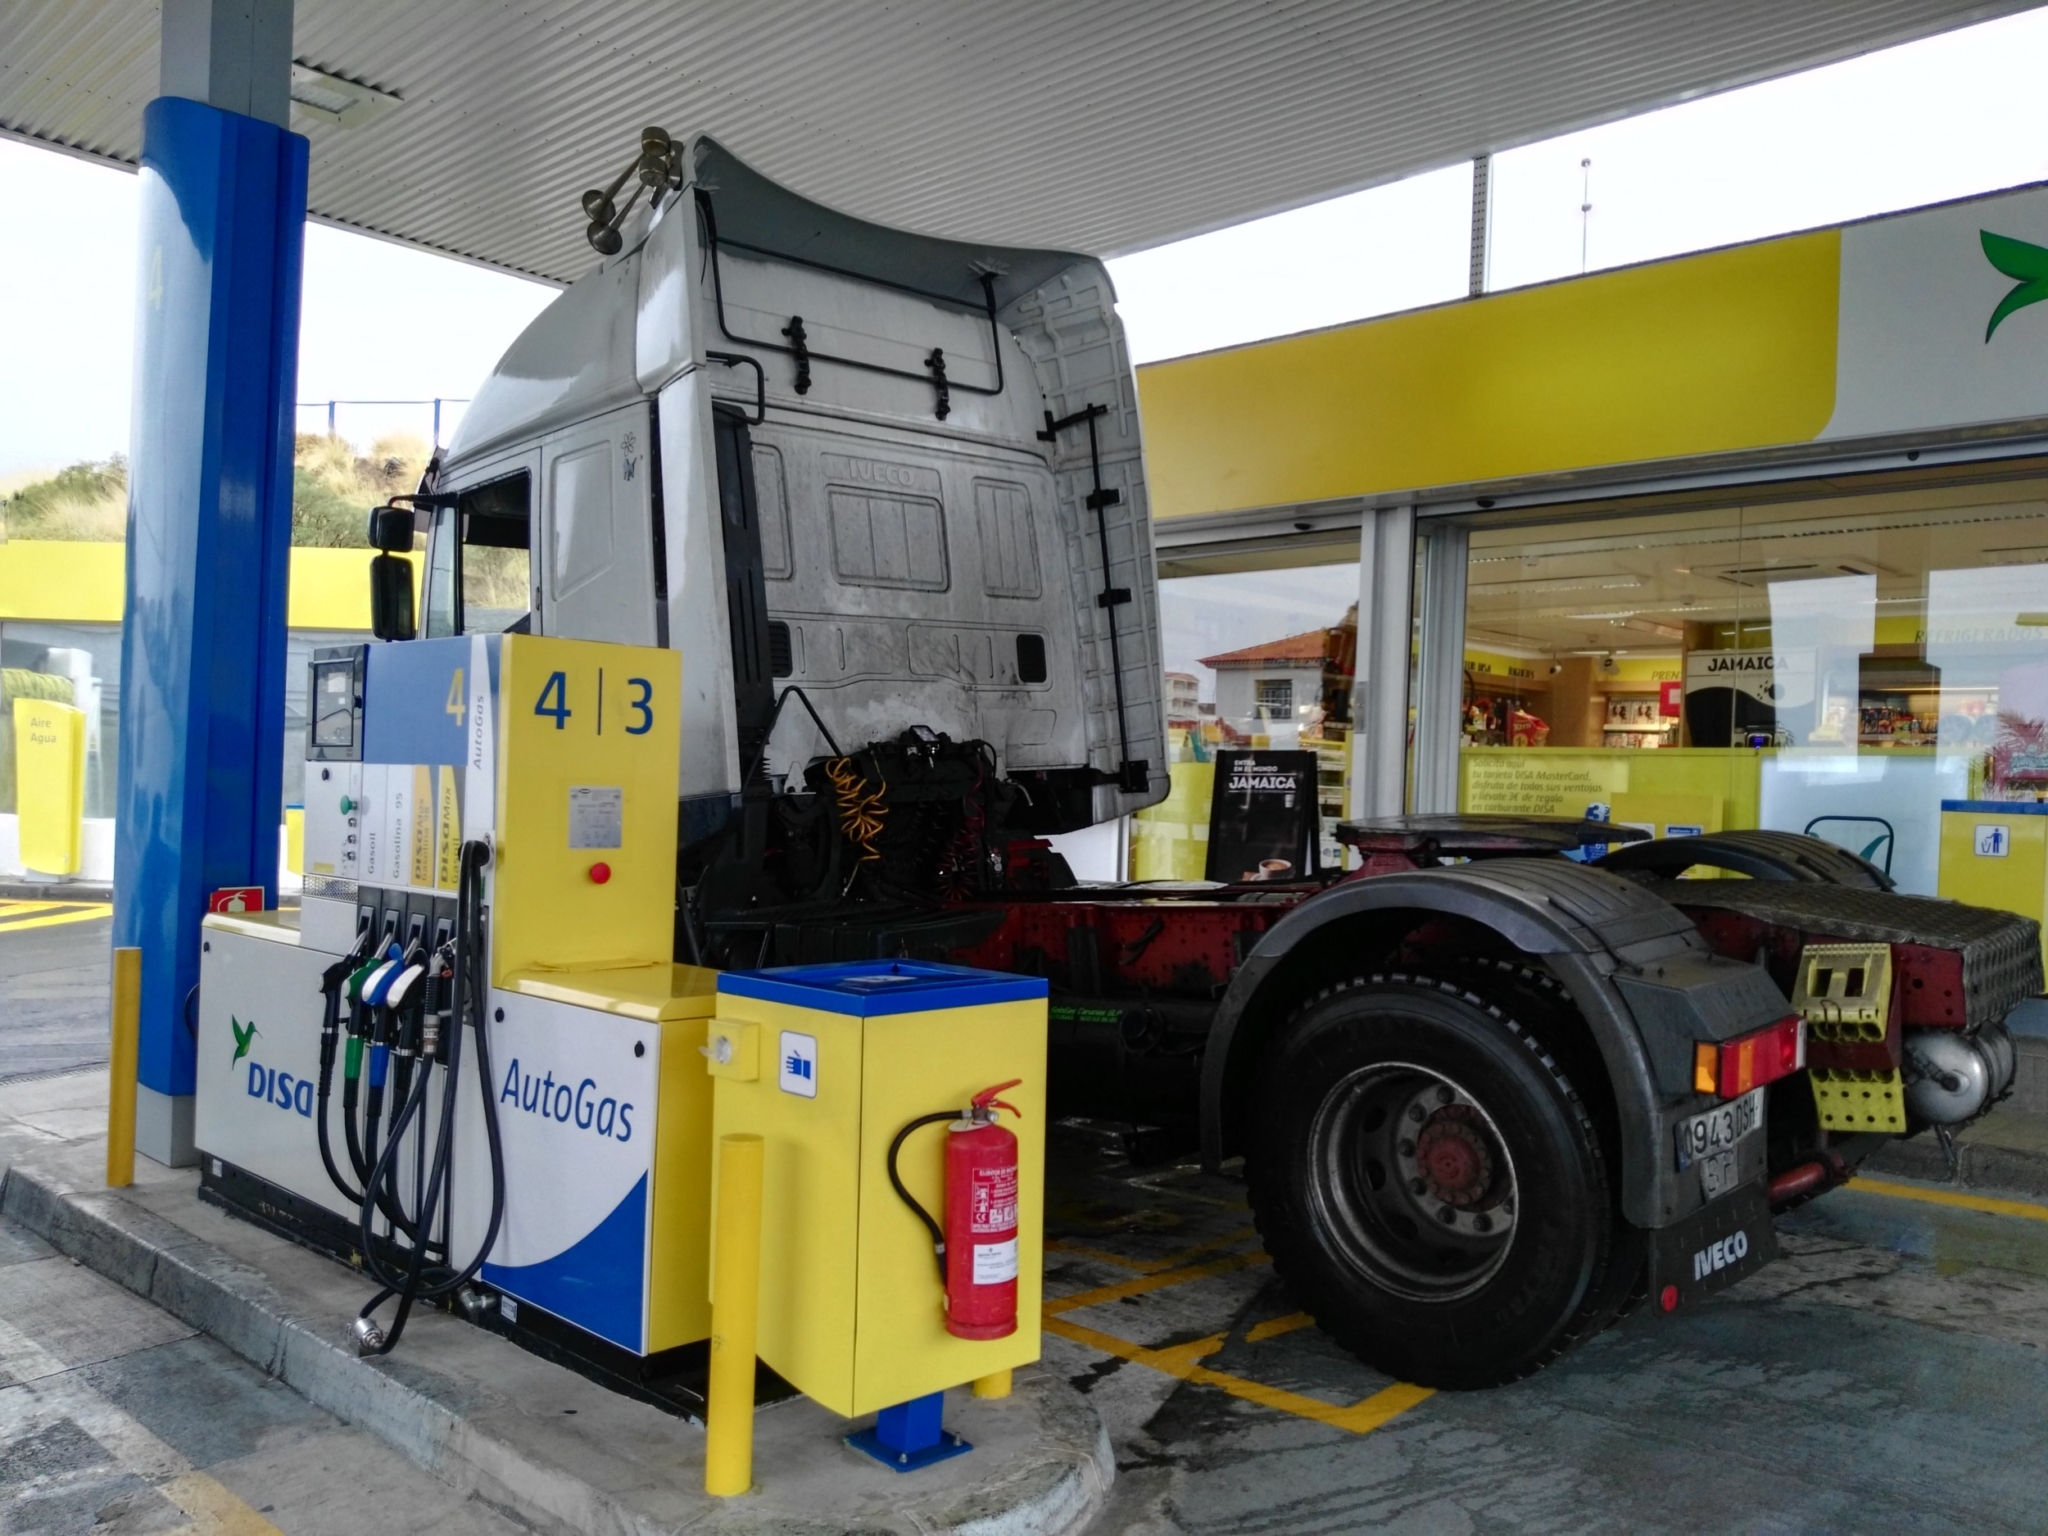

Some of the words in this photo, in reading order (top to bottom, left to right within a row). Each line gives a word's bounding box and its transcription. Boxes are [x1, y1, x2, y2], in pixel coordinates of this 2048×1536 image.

[848, 458, 915, 487] IVECO
[1914, 627, 2044, 644] REFRIGERADOS
[1707, 656, 1789, 672] JAMAICA
[446, 668, 467, 727] 4
[534, 670, 572, 730] 4
[625, 677, 654, 735] 3
[31, 717, 52, 728] Aire
[472, 694, 485, 771] AutoGas
[30, 733, 57, 744] Agua
[1228, 776, 1297, 789] JAMAICA
[1472, 780, 1505, 792] disfruta
[1506, 782, 1519, 790] de
[1520, 782, 1544, 791] todas
[1546, 784, 1561, 792] sus
[1564, 783, 1603, 794] ventajas
[1484, 771, 1513, 781] tarjeta
[1515, 771, 1534, 780] DISA
[1536, 771, 1592, 782] MasterCard,
[395, 792, 403, 809] 95
[1471, 793, 1478, 802] y
[1522, 793, 1533, 801] de
[1535, 794, 1564, 804] regalo
[1472, 803, 1482, 811] en
[1484, 803, 1532, 813] carburante
[1533, 804, 1555, 814] DISA
[367, 832, 376, 875] Gasoil
[392, 818, 402, 879] Gasolina
[421, 827, 429, 881] Gasolina
[500, 1058, 634, 1143] AutoGas
[1683, 1110, 1734, 1160] 0943
[1736, 1094, 1756, 1138] DSH
[1694, 1229, 1749, 1282] IVECO
